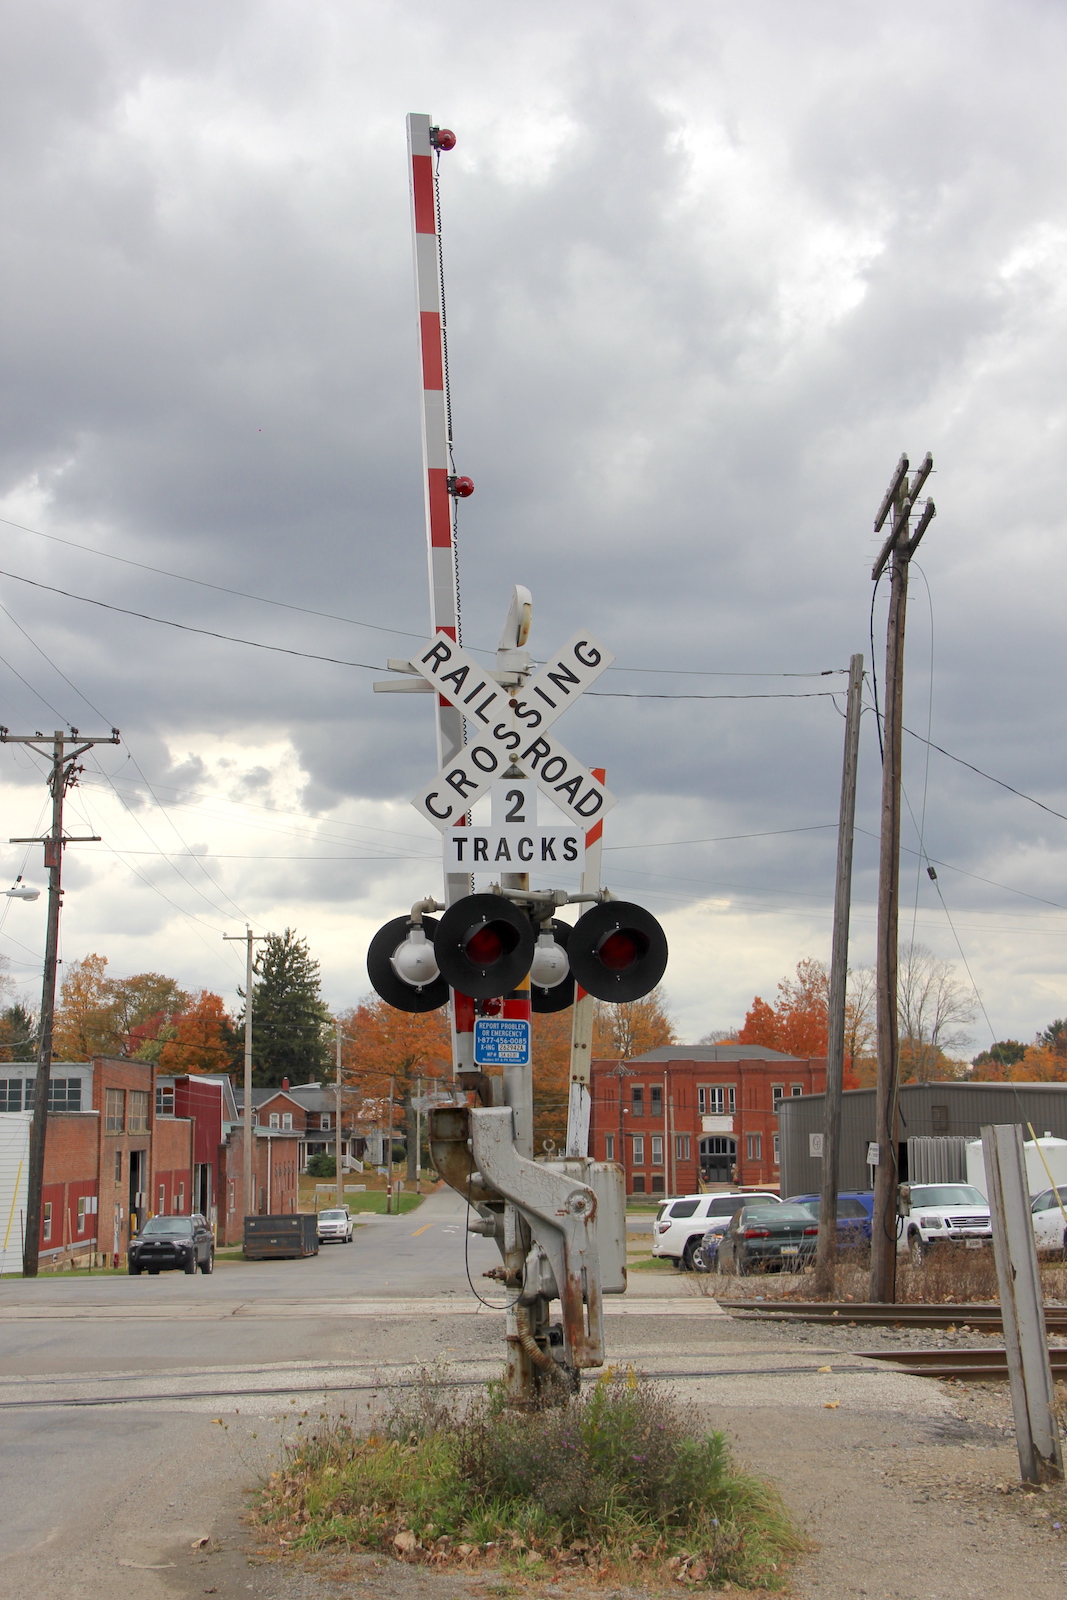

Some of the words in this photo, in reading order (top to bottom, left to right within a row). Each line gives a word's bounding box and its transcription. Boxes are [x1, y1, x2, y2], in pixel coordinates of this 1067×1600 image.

[421, 640, 497, 725] RAIL
[520, 737, 604, 817] ROAD
[425, 640, 601, 820] CROSSING
[452, 836, 578, 862] TRACKS
[505, 789, 526, 823] 2
